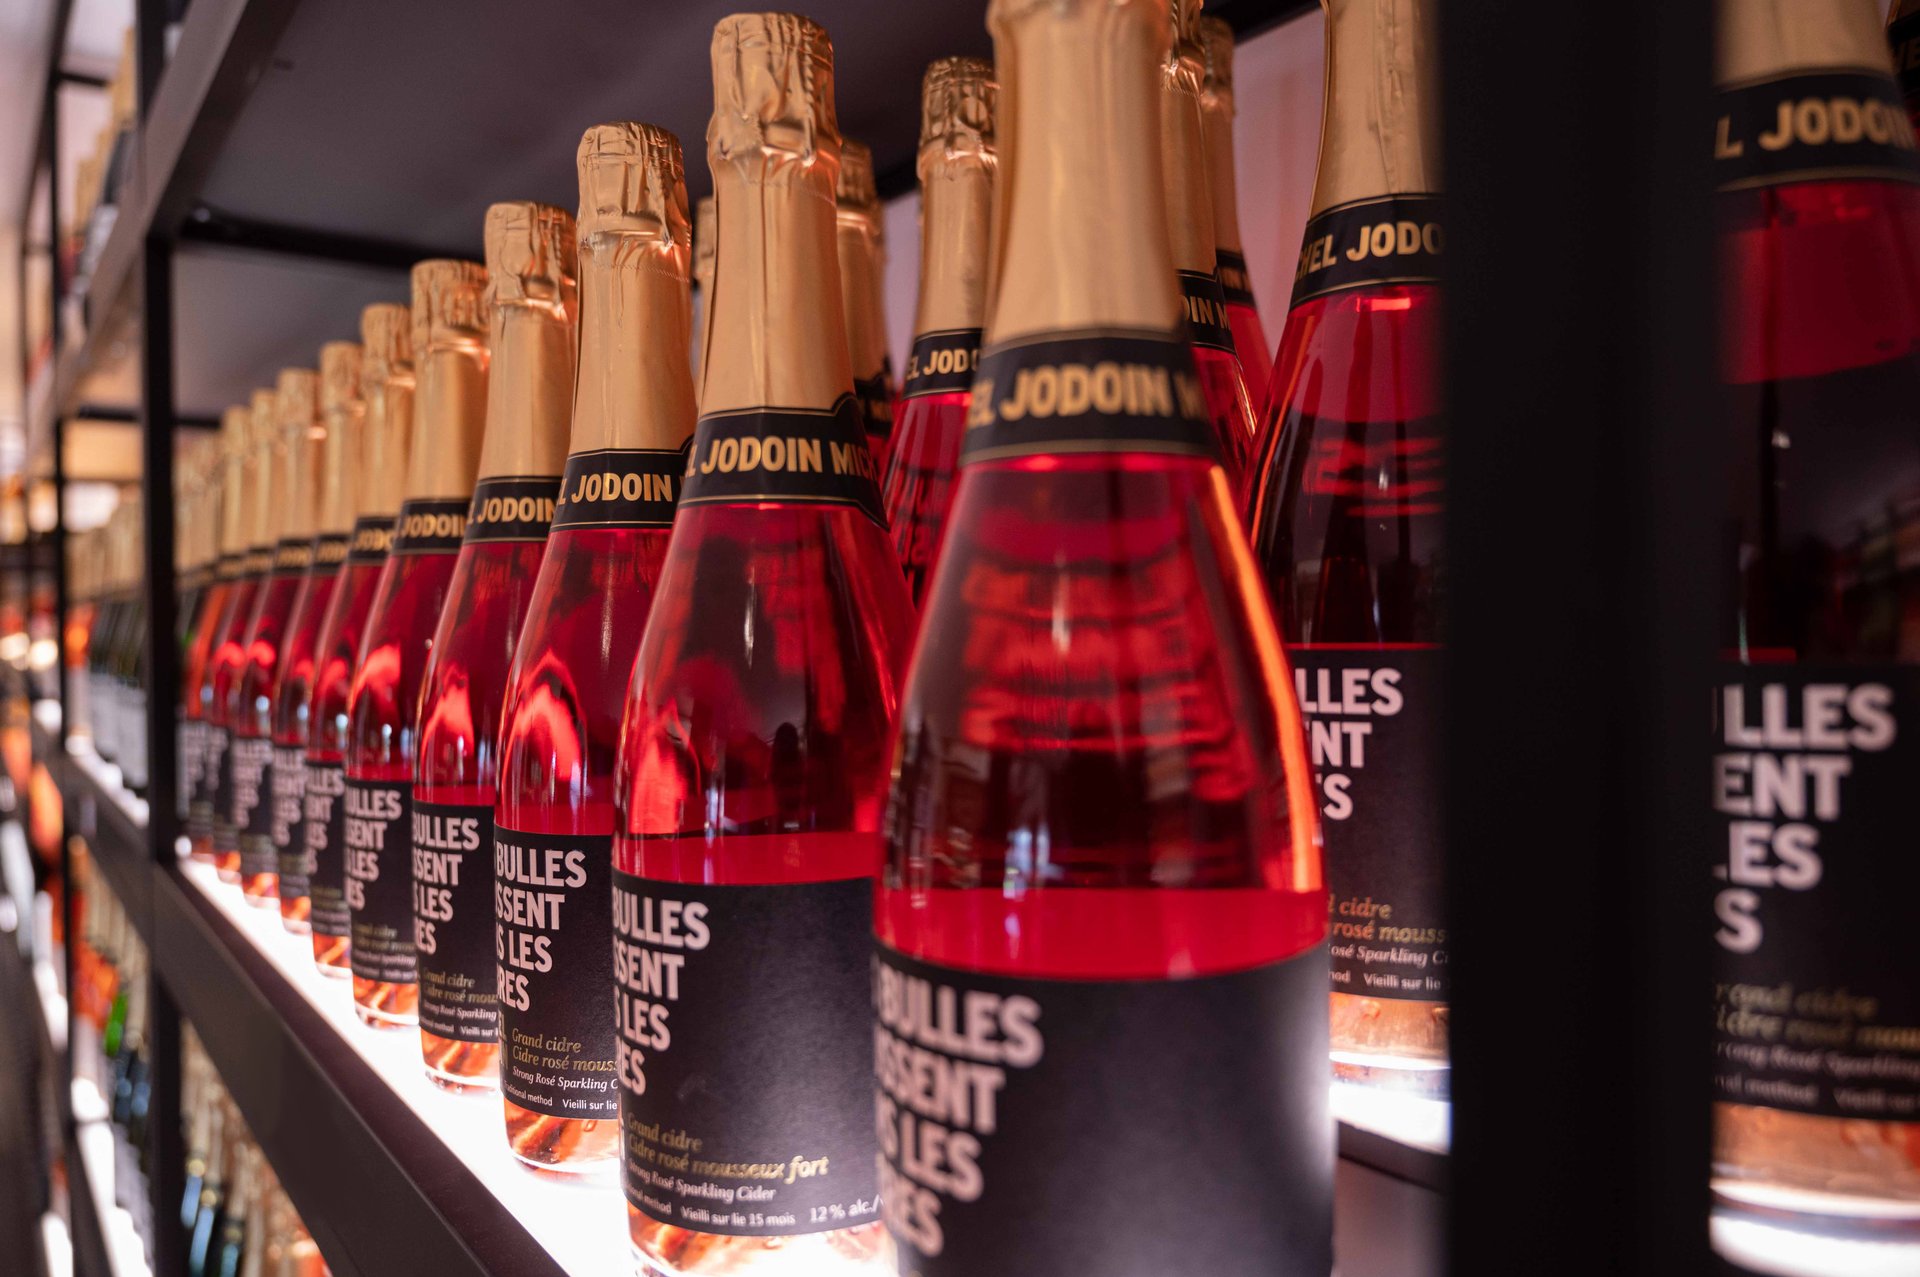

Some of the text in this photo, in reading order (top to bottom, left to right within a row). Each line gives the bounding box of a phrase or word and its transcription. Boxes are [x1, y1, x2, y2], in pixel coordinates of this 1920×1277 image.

[1000, 361, 1176, 422] JODOIN
[700, 434, 824, 476] JODOIN
[571, 472, 674, 504] JODOIN
[1711, 682, 1897, 753] LLES
[1305, 719, 1373, 769] NT
[496, 840, 587, 888] BULLES
[1712, 820, 1824, 892] ES
[420, 884, 454, 923] LES
[612, 885, 711, 951] BULLES
[1339, 896, 1393, 920] cidre
[1331, 919, 1376, 941] rosé
[508, 929, 553, 973] LES
[1356, 945, 1428, 969] Sparkling
[447, 973, 476, 989] cidre
[1363, 972, 1400, 989] Vieilli
[1401, 977, 1422, 991] sur
[456, 1006, 497, 1022] Sparkling
[622, 992, 671, 1052] LES
[512, 1027, 582, 1053] Grand cidre
[512, 1045, 539, 1066] Cidre
[541, 1055, 570, 1071] rosé
[512, 1065, 534, 1085] Strong
[535, 1072, 556, 1086] Rosé
[557, 1076, 608, 1093] Sparkling
[527, 1093, 553, 1107] method
[562, 1098, 587, 1110] Vieilli
[589, 1101, 604, 1111] sur
[606, 1098, 618, 1110] lie
[661, 1128, 704, 1153] cidre
[901, 1109, 984, 1202] LES
[657, 1152, 690, 1173] rosé
[691, 1160, 786, 1180] mousseux
[784, 1154, 830, 1185] fort
[675, 1179, 735, 1205] Sparkling
[735, 1184, 777, 1202] Cider
[680, 1205, 710, 1223] Vieilli
[711, 1212, 730, 1226] sur
[731, 1211, 747, 1227] lie
[748, 1212, 764, 1228] 15
[765, 1210, 796, 1228] mois
